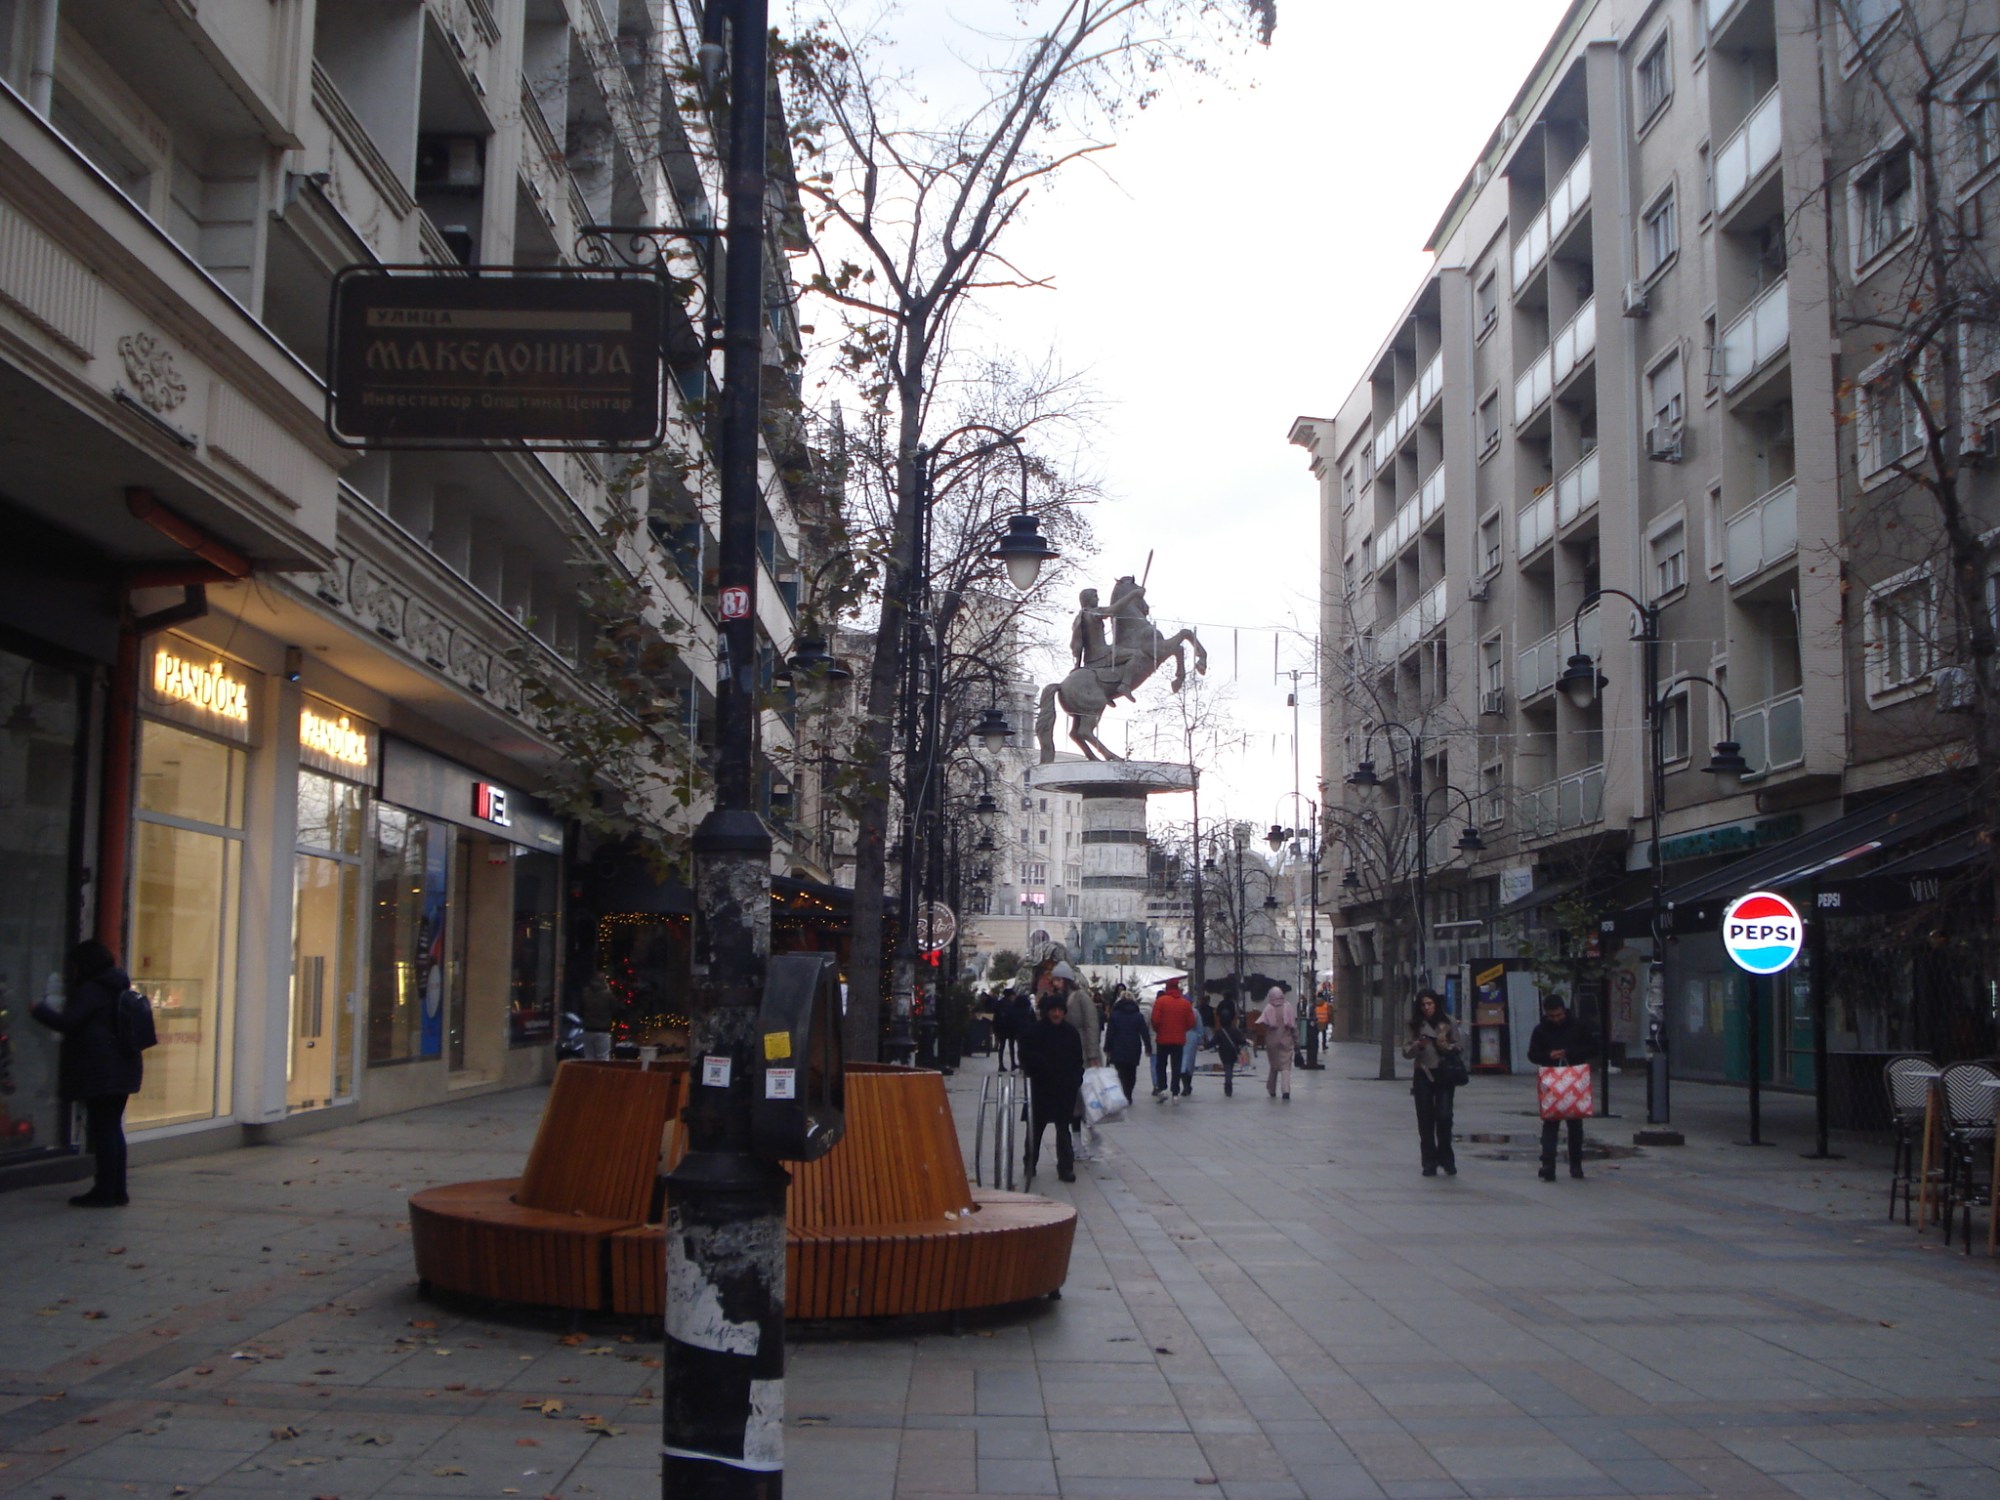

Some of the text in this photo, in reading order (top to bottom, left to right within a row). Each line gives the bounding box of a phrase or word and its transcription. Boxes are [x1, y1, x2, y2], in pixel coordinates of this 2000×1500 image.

[376, 310, 452, 325] УЛИЦА
[365, 339, 632, 376] МАКЕДОНИЈА
[481, 393, 562, 410] Општина
[567, 396, 632, 412] Центар
[722, 591, 746, 615] 87
[154, 651, 248, 722] PANDORA
[1817, 892, 1841, 908] PEPSI
[1730, 924, 1796, 942] PEPSI
